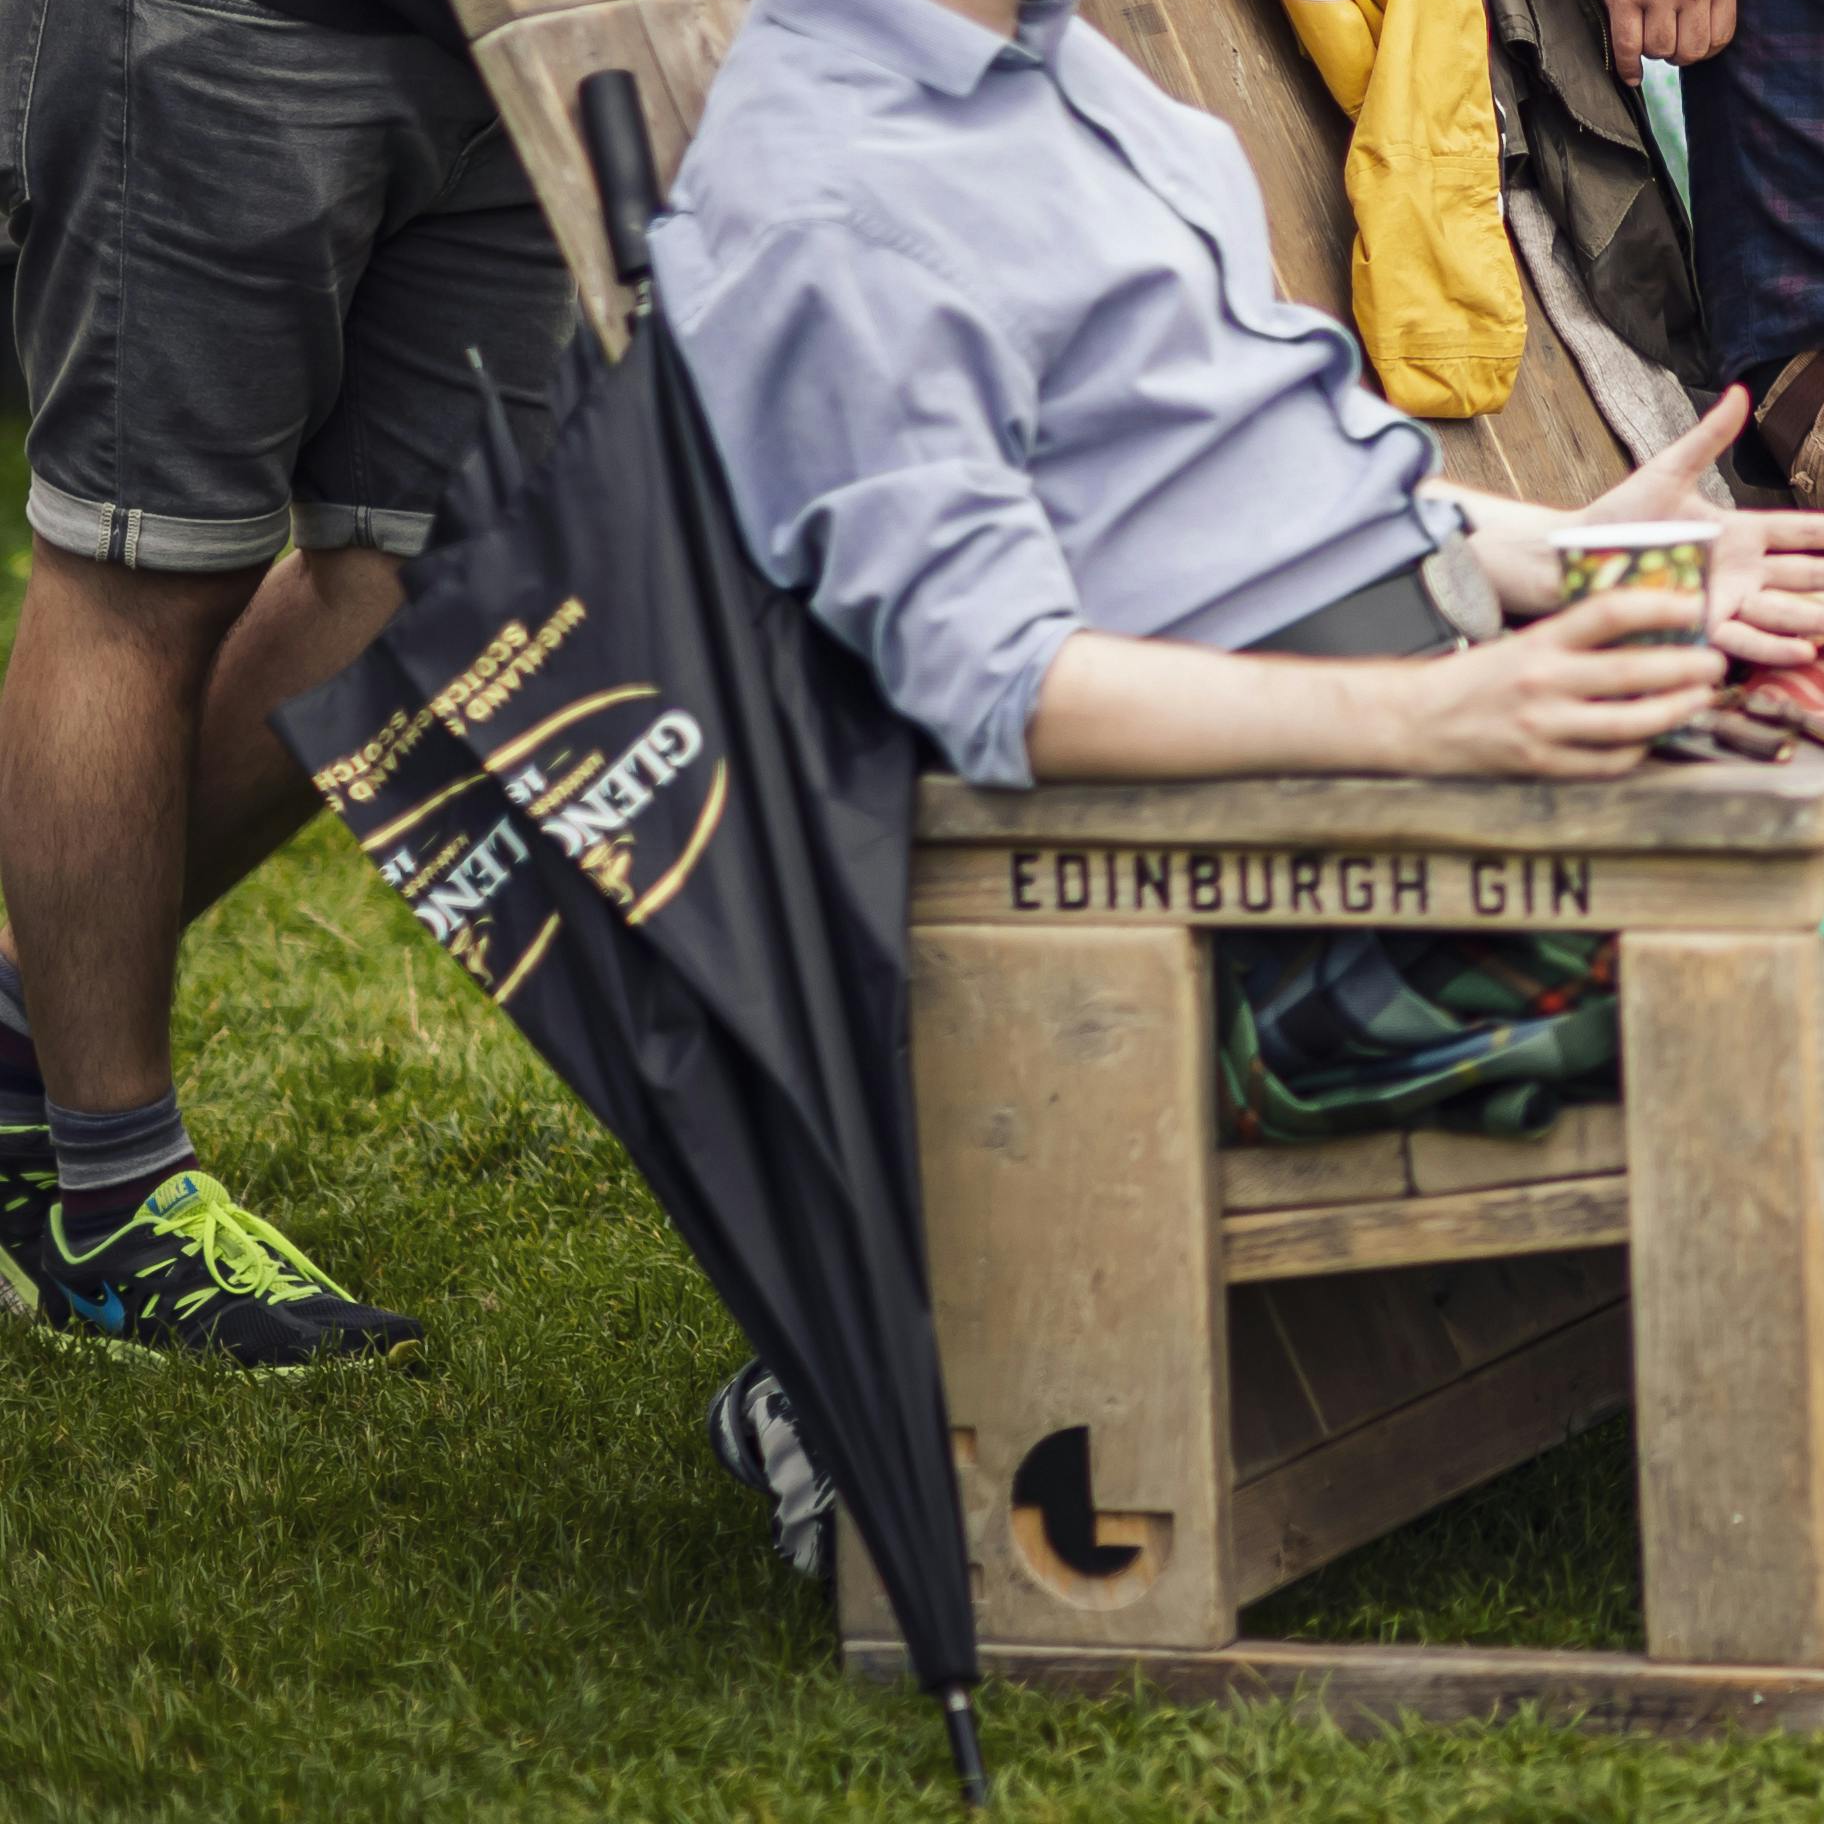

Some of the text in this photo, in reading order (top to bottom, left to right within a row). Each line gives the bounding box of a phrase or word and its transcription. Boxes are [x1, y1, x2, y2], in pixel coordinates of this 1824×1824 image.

[430, 619, 529, 718] SCOTCH
[1010, 851, 1593, 916] EDINBURGH GIN
